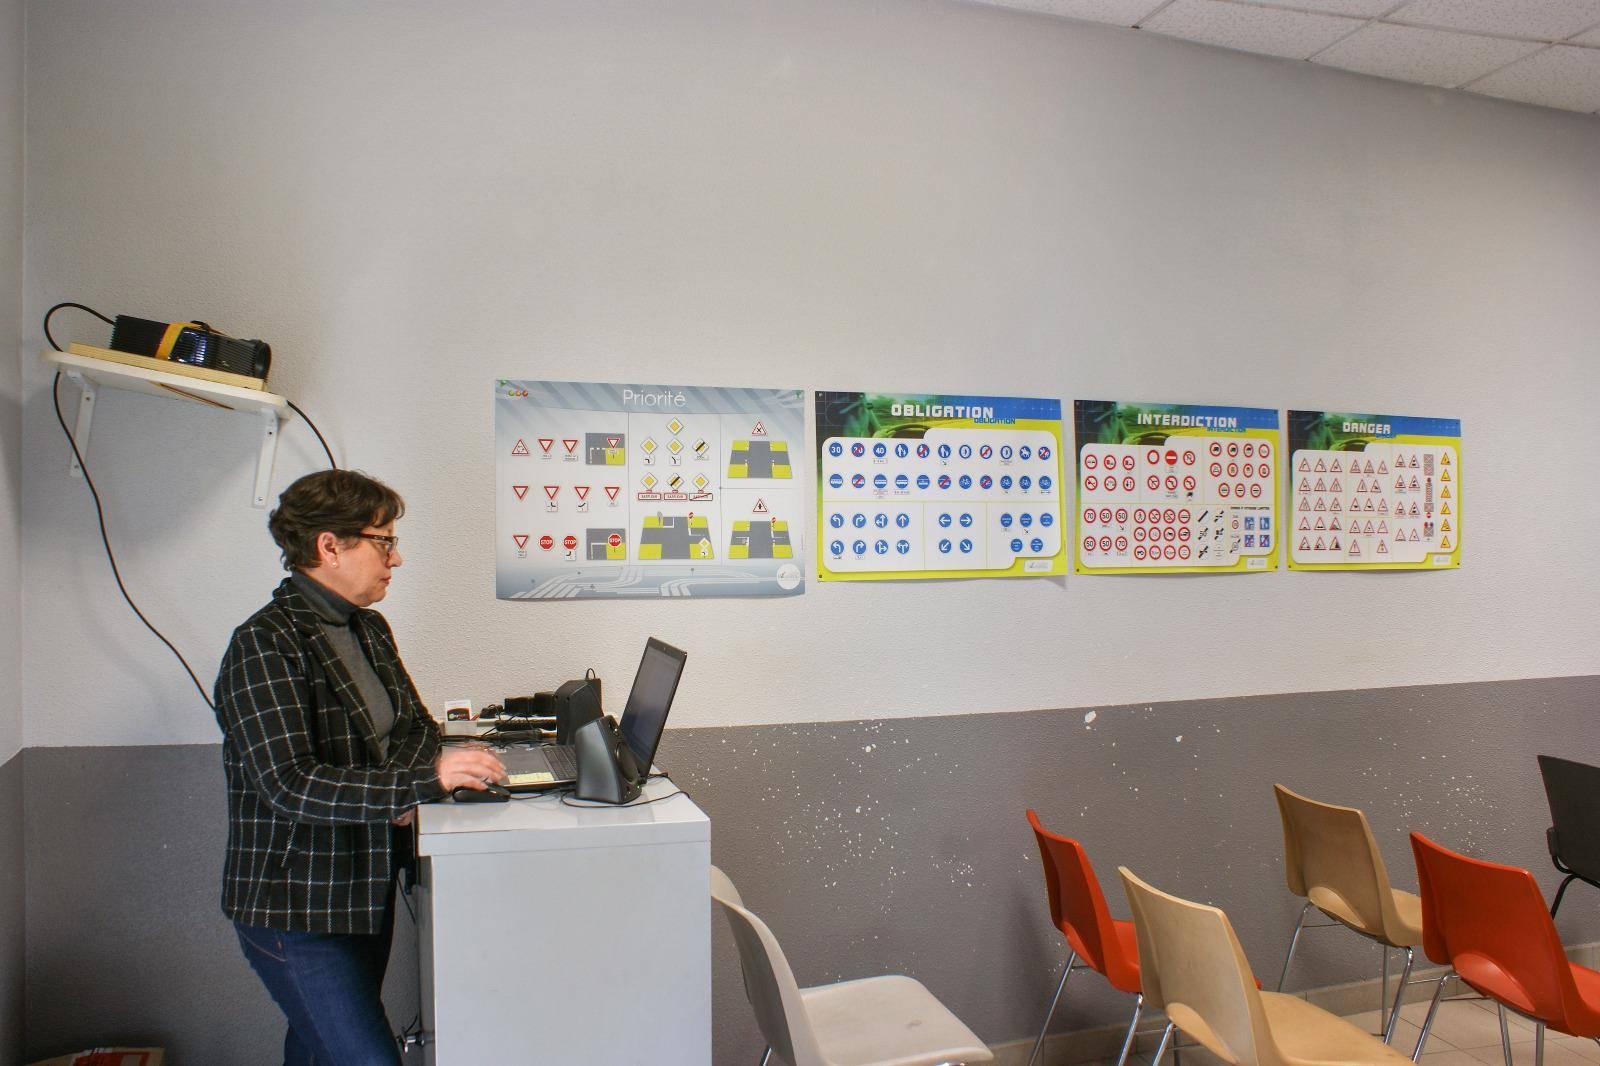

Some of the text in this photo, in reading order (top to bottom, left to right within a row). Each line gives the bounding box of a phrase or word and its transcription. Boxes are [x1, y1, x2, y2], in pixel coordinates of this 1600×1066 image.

[622, 389, 687, 408] Priorité
[891, 404, 994, 418] OBLIGATION
[1137, 413, 1237, 428] INTERDICTION
[1342, 422, 1391, 434] DANGER
[831, 446, 841, 454] 30
[875, 447, 885, 455] 40
